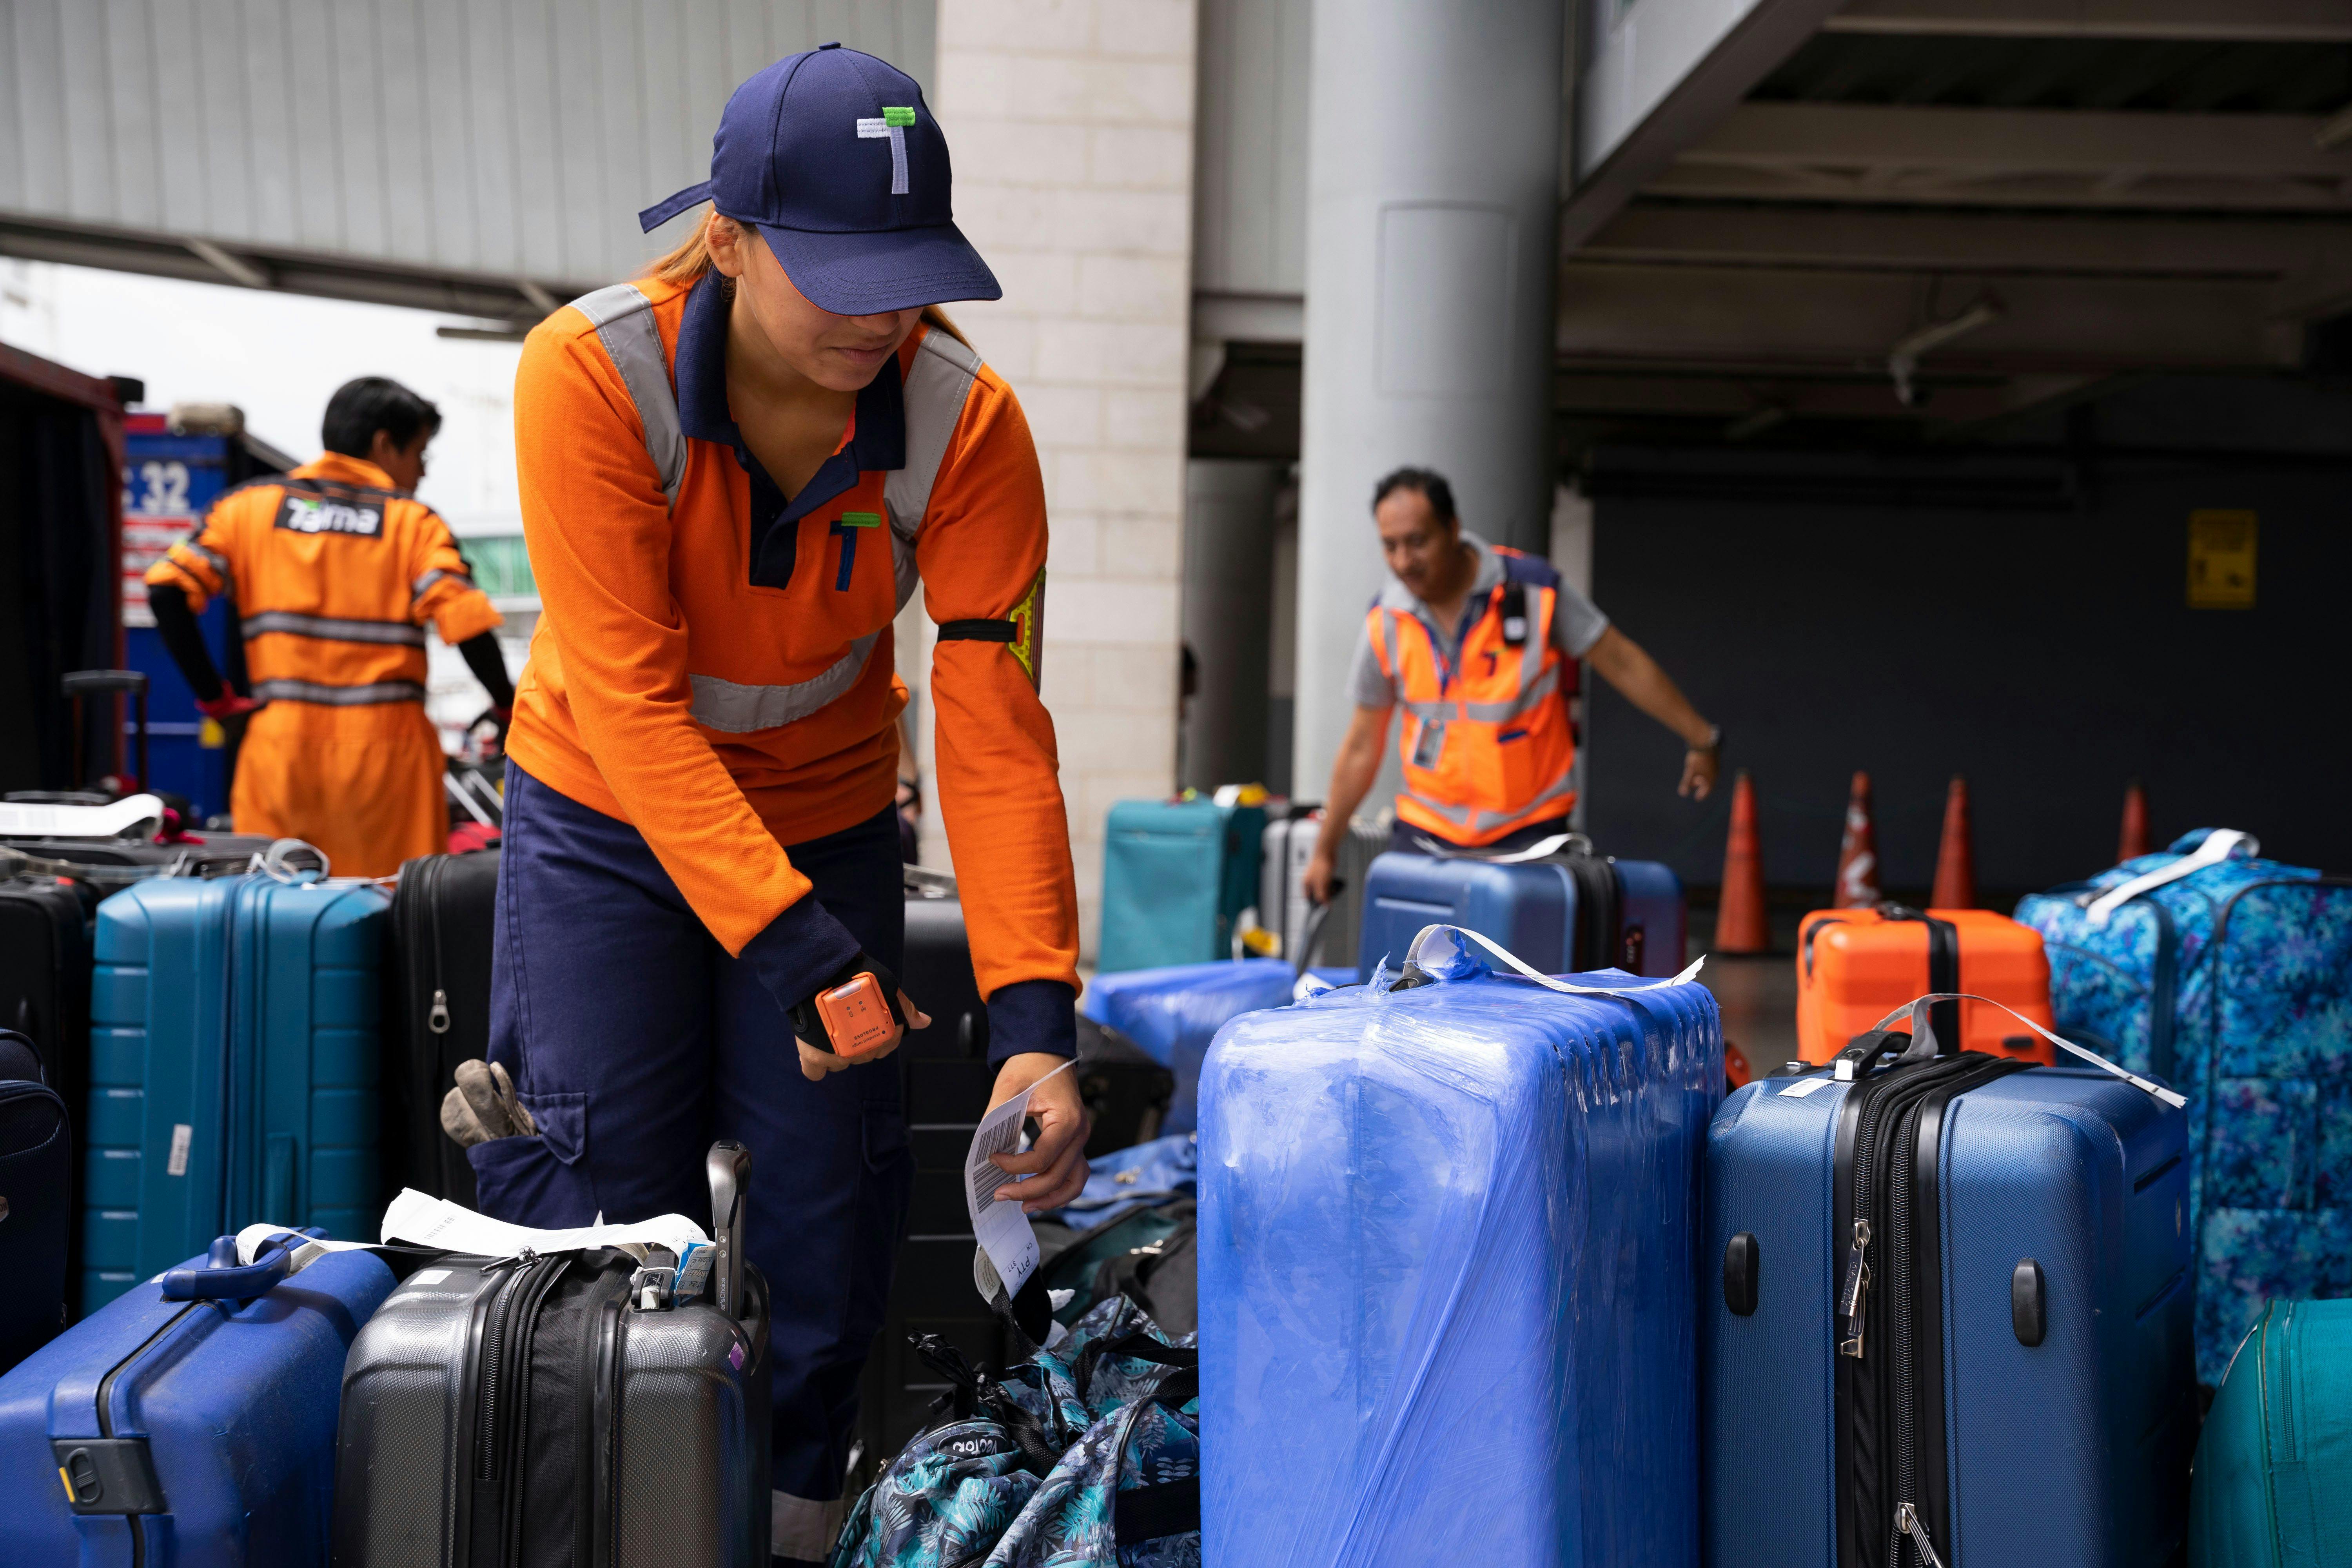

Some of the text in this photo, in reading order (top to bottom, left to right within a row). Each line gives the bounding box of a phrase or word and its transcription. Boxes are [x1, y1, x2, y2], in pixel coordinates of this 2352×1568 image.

[857, 107, 915, 194] T
[854, 1026, 878, 1040] PROGLOVE
[1017, 1256, 1031, 1278] PTY
